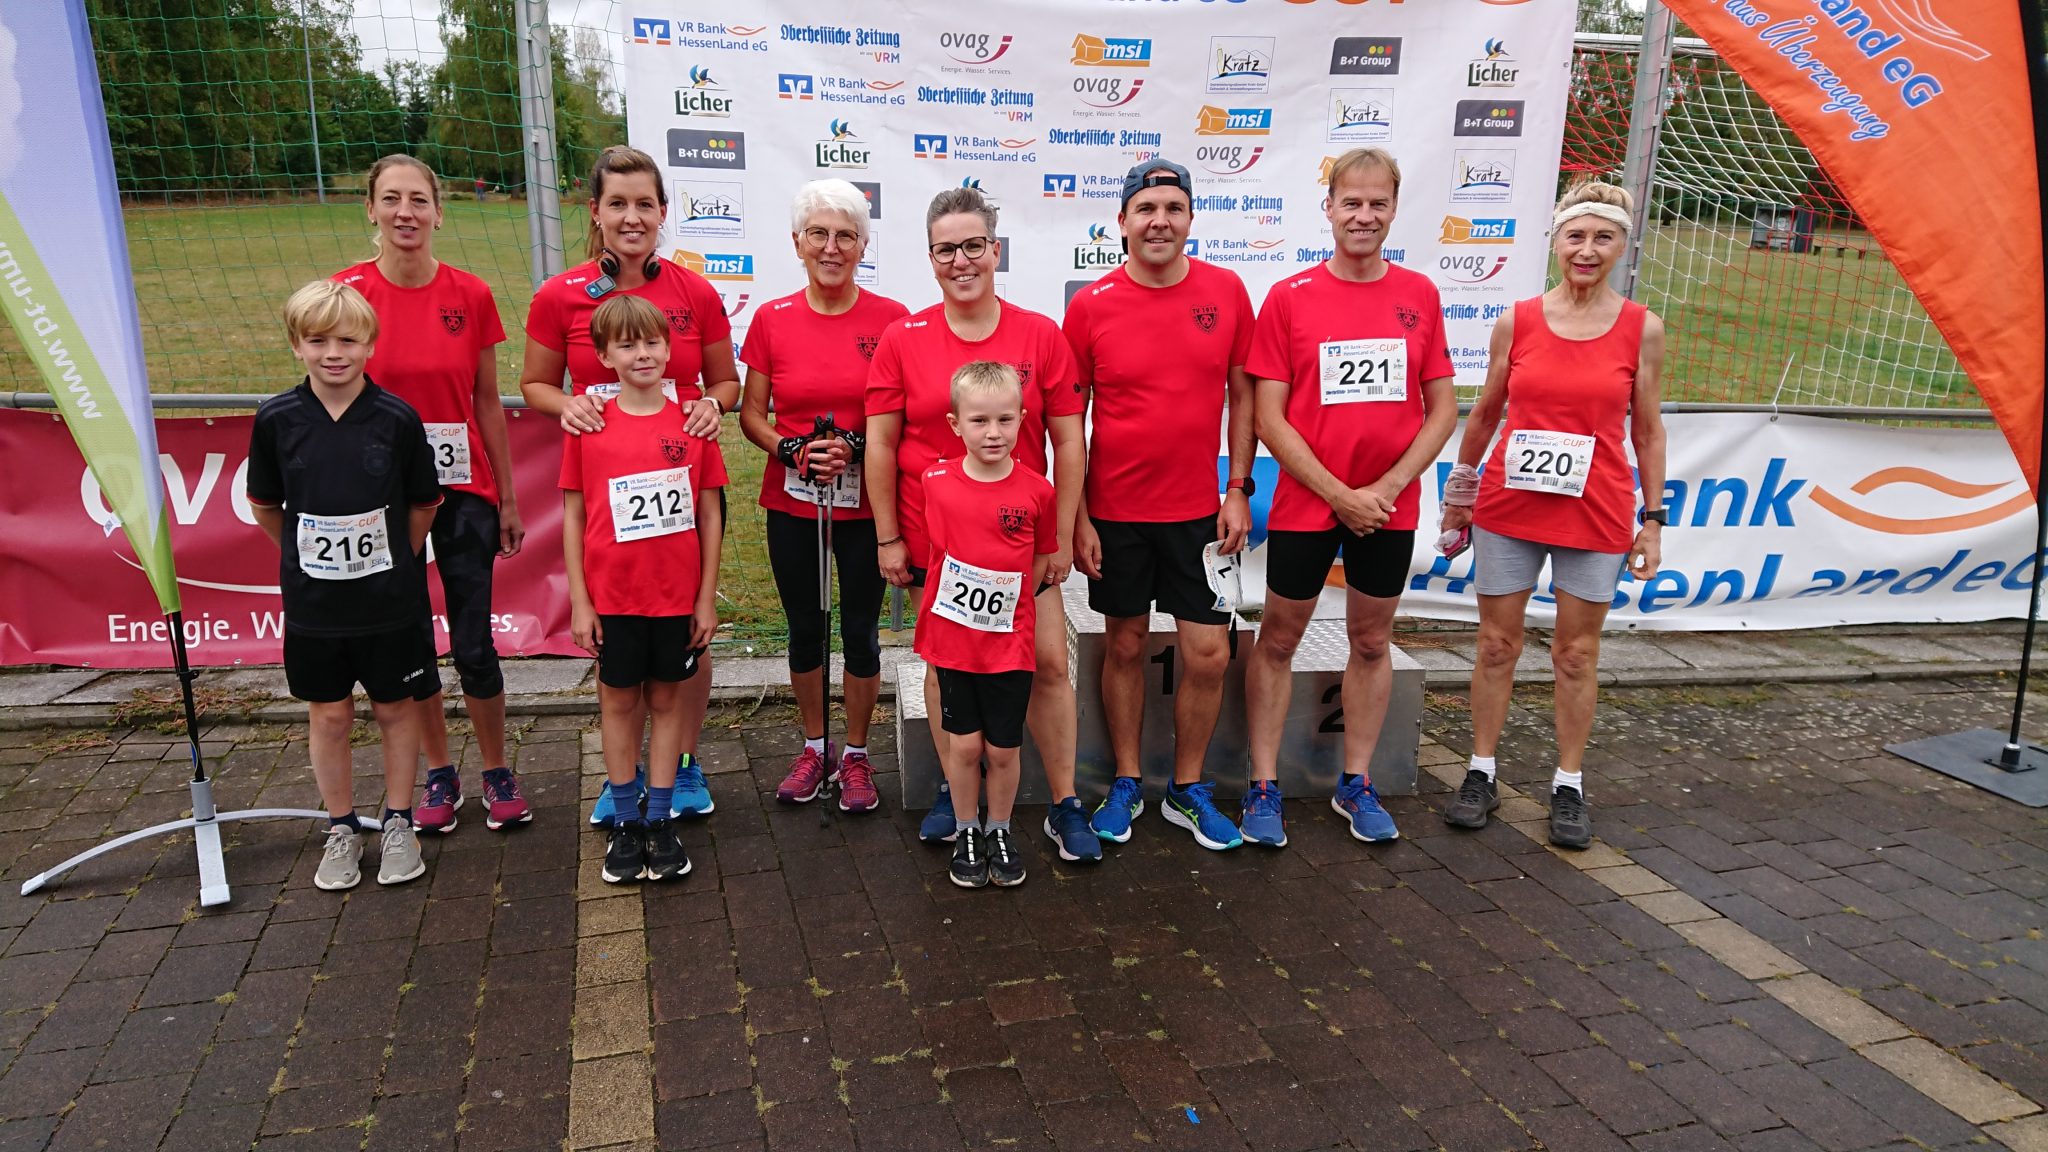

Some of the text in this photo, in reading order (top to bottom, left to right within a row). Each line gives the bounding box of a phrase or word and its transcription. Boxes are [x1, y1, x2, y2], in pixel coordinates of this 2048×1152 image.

[677, 21, 727, 35] VR Bank
[678, 36, 768, 52] HessenLand eG
[856, 28, 900, 48] Zeitung
[940, 32, 990, 58] ovag
[874, 52, 900, 63] VRM
[1105, 41, 1142, 59] msi
[1815, 0, 1944, 109] and eG
[1222, 53, 1260, 72] Kratz
[1340, 56, 1391, 68] B+T Group
[820, 77, 867, 89] VR Bank
[1468, 62, 1519, 87] Licher
[1759, 15, 1890, 141] Überzeugung
[820, 91, 906, 105] HessenLand eG
[990, 88, 1034, 108] Zeitung
[1073, 77, 1121, 102] ovag
[674, 90, 733, 116] Licher
[1008, 111, 1033, 122] VRM
[1227, 110, 1264, 128] msi
[1343, 104, 1380, 122] Kratz
[1464, 119, 1514, 130] B+T Group
[954, 136, 999, 148] VR Bank
[1120, 129, 1161, 148] Zeitung
[678, 148, 736, 162] B+T Group
[816, 143, 871, 168] Licher
[954, 150, 1036, 163] HessenLand eG
[1136, 151, 1159, 161] VRM
[1196, 146, 1242, 169] ovag
[1082, 175, 1125, 185] VR Bank
[1465, 165, 1501, 182] Kratz
[1082, 189, 1122, 198] HessenL
[690, 197, 731, 216] Kratz
[1242, 195, 1283, 212] Zeitung
[1258, 215, 1282, 225] VRM
[1472, 220, 1508, 237] msi
[1205, 239, 1249, 249] VR Bank
[707, 256, 744, 273] msi
[1074, 247, 1125, 270] Licher
[1205, 252, 1268, 262] HessenLand
[1270, 252, 1285, 262] eG
[1439, 256, 1486, 278] ovag
[1462, 347, 1487, 356] Bank
[1339, 358, 1389, 385] 221
[1519, 449, 1573, 477] 220
[1636, 457, 1807, 527] ank
[629, 489, 683, 521] 212
[315, 533, 374, 562] 216
[952, 582, 1005, 615] 206
[1150, 645, 1175, 695] 1
[1318, 684, 1345, 733] 2
